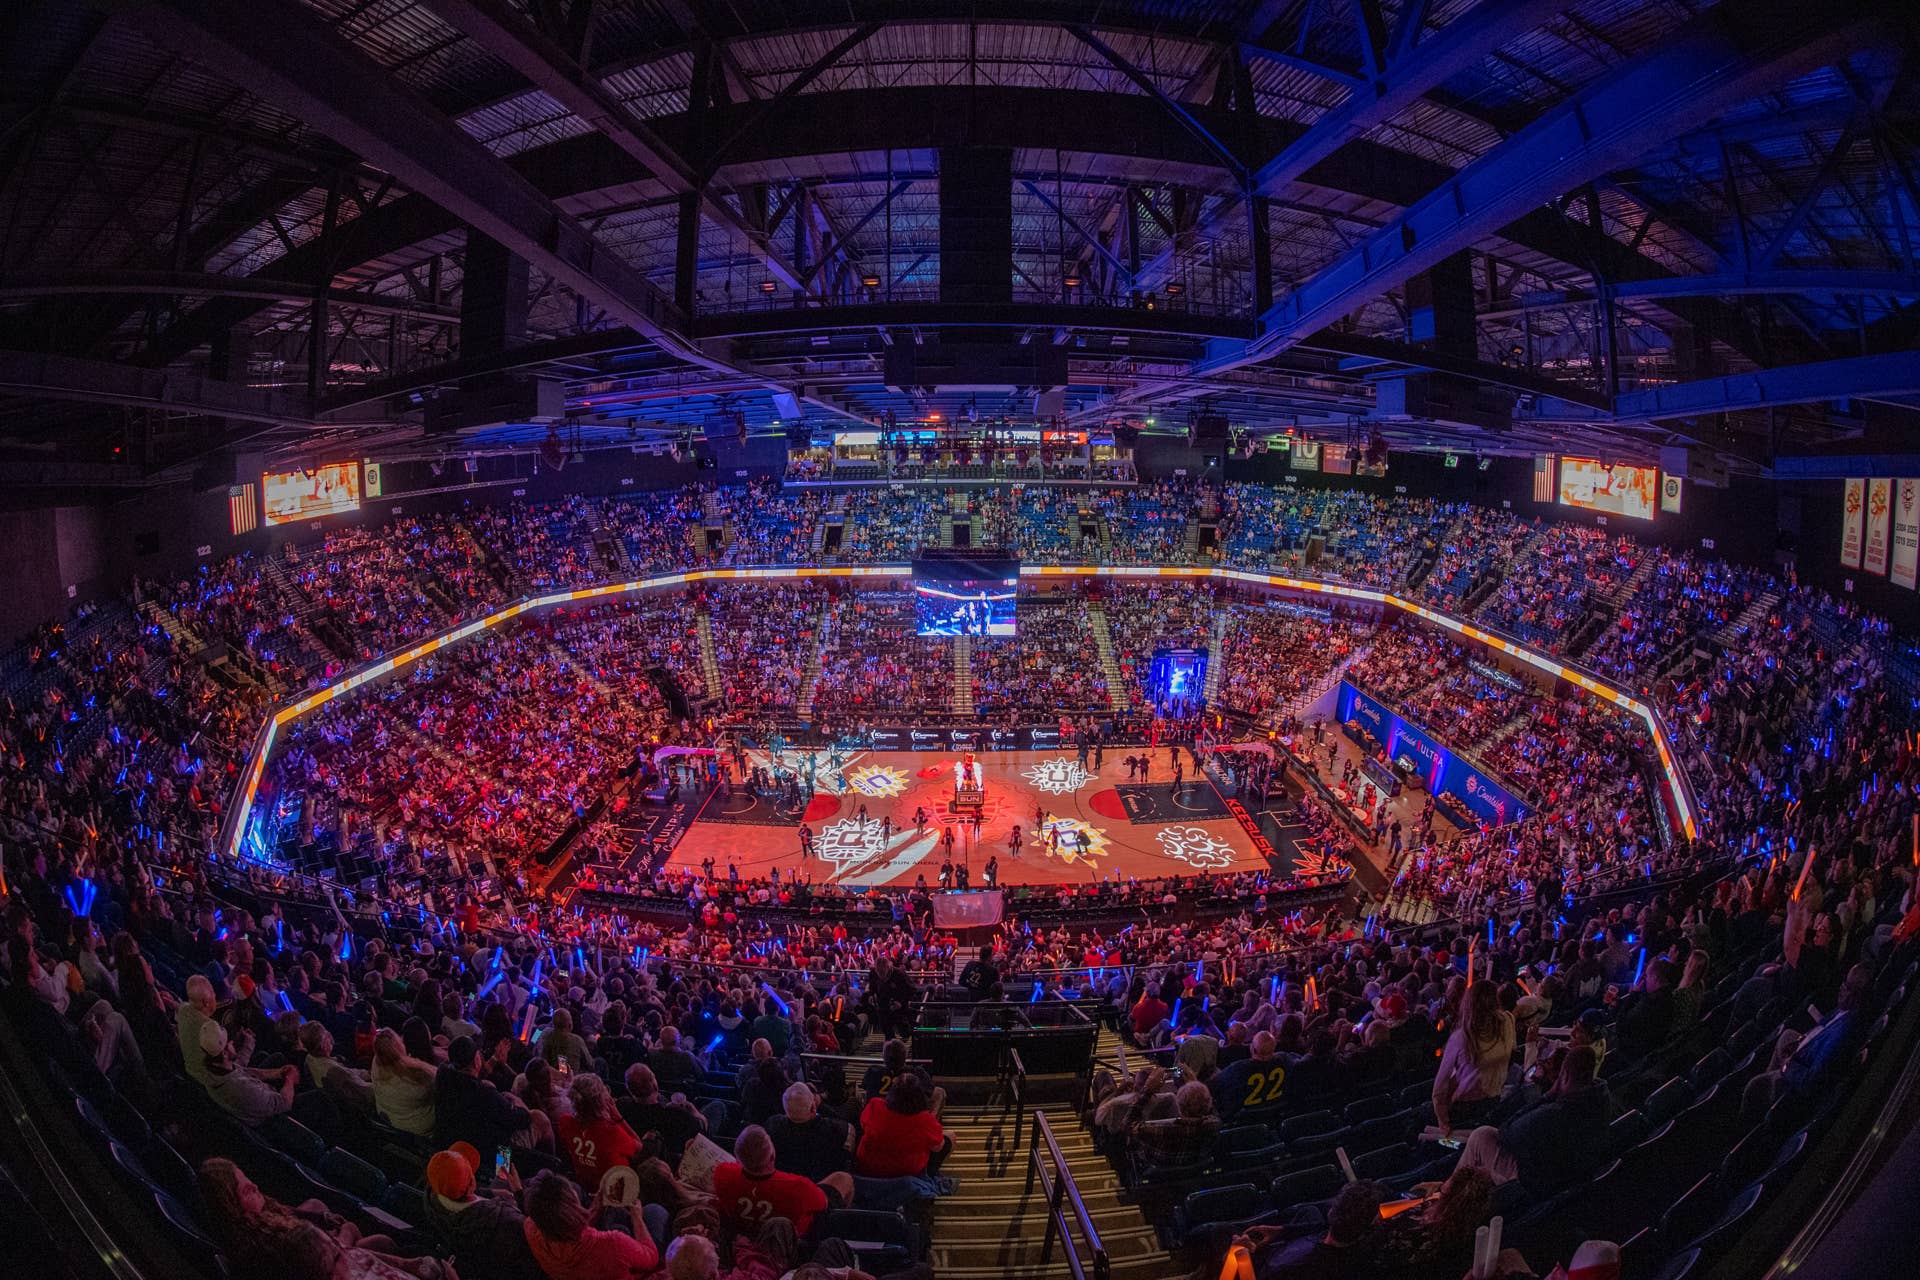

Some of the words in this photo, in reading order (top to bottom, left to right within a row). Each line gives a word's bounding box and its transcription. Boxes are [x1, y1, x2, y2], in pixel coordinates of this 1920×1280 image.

[512, 489, 526, 497] 103
[621, 478, 634, 486] 104
[311, 521, 322, 531] 101
[1702, 538, 1715, 549] 113
[1420, 743, 1444, 768] ULTRA
[1225, 799, 1279, 857] KEESUSK
[1243, 1066, 1286, 1106] 22
[572, 1136, 598, 1161] 22
[738, 1197, 774, 1222] 22
